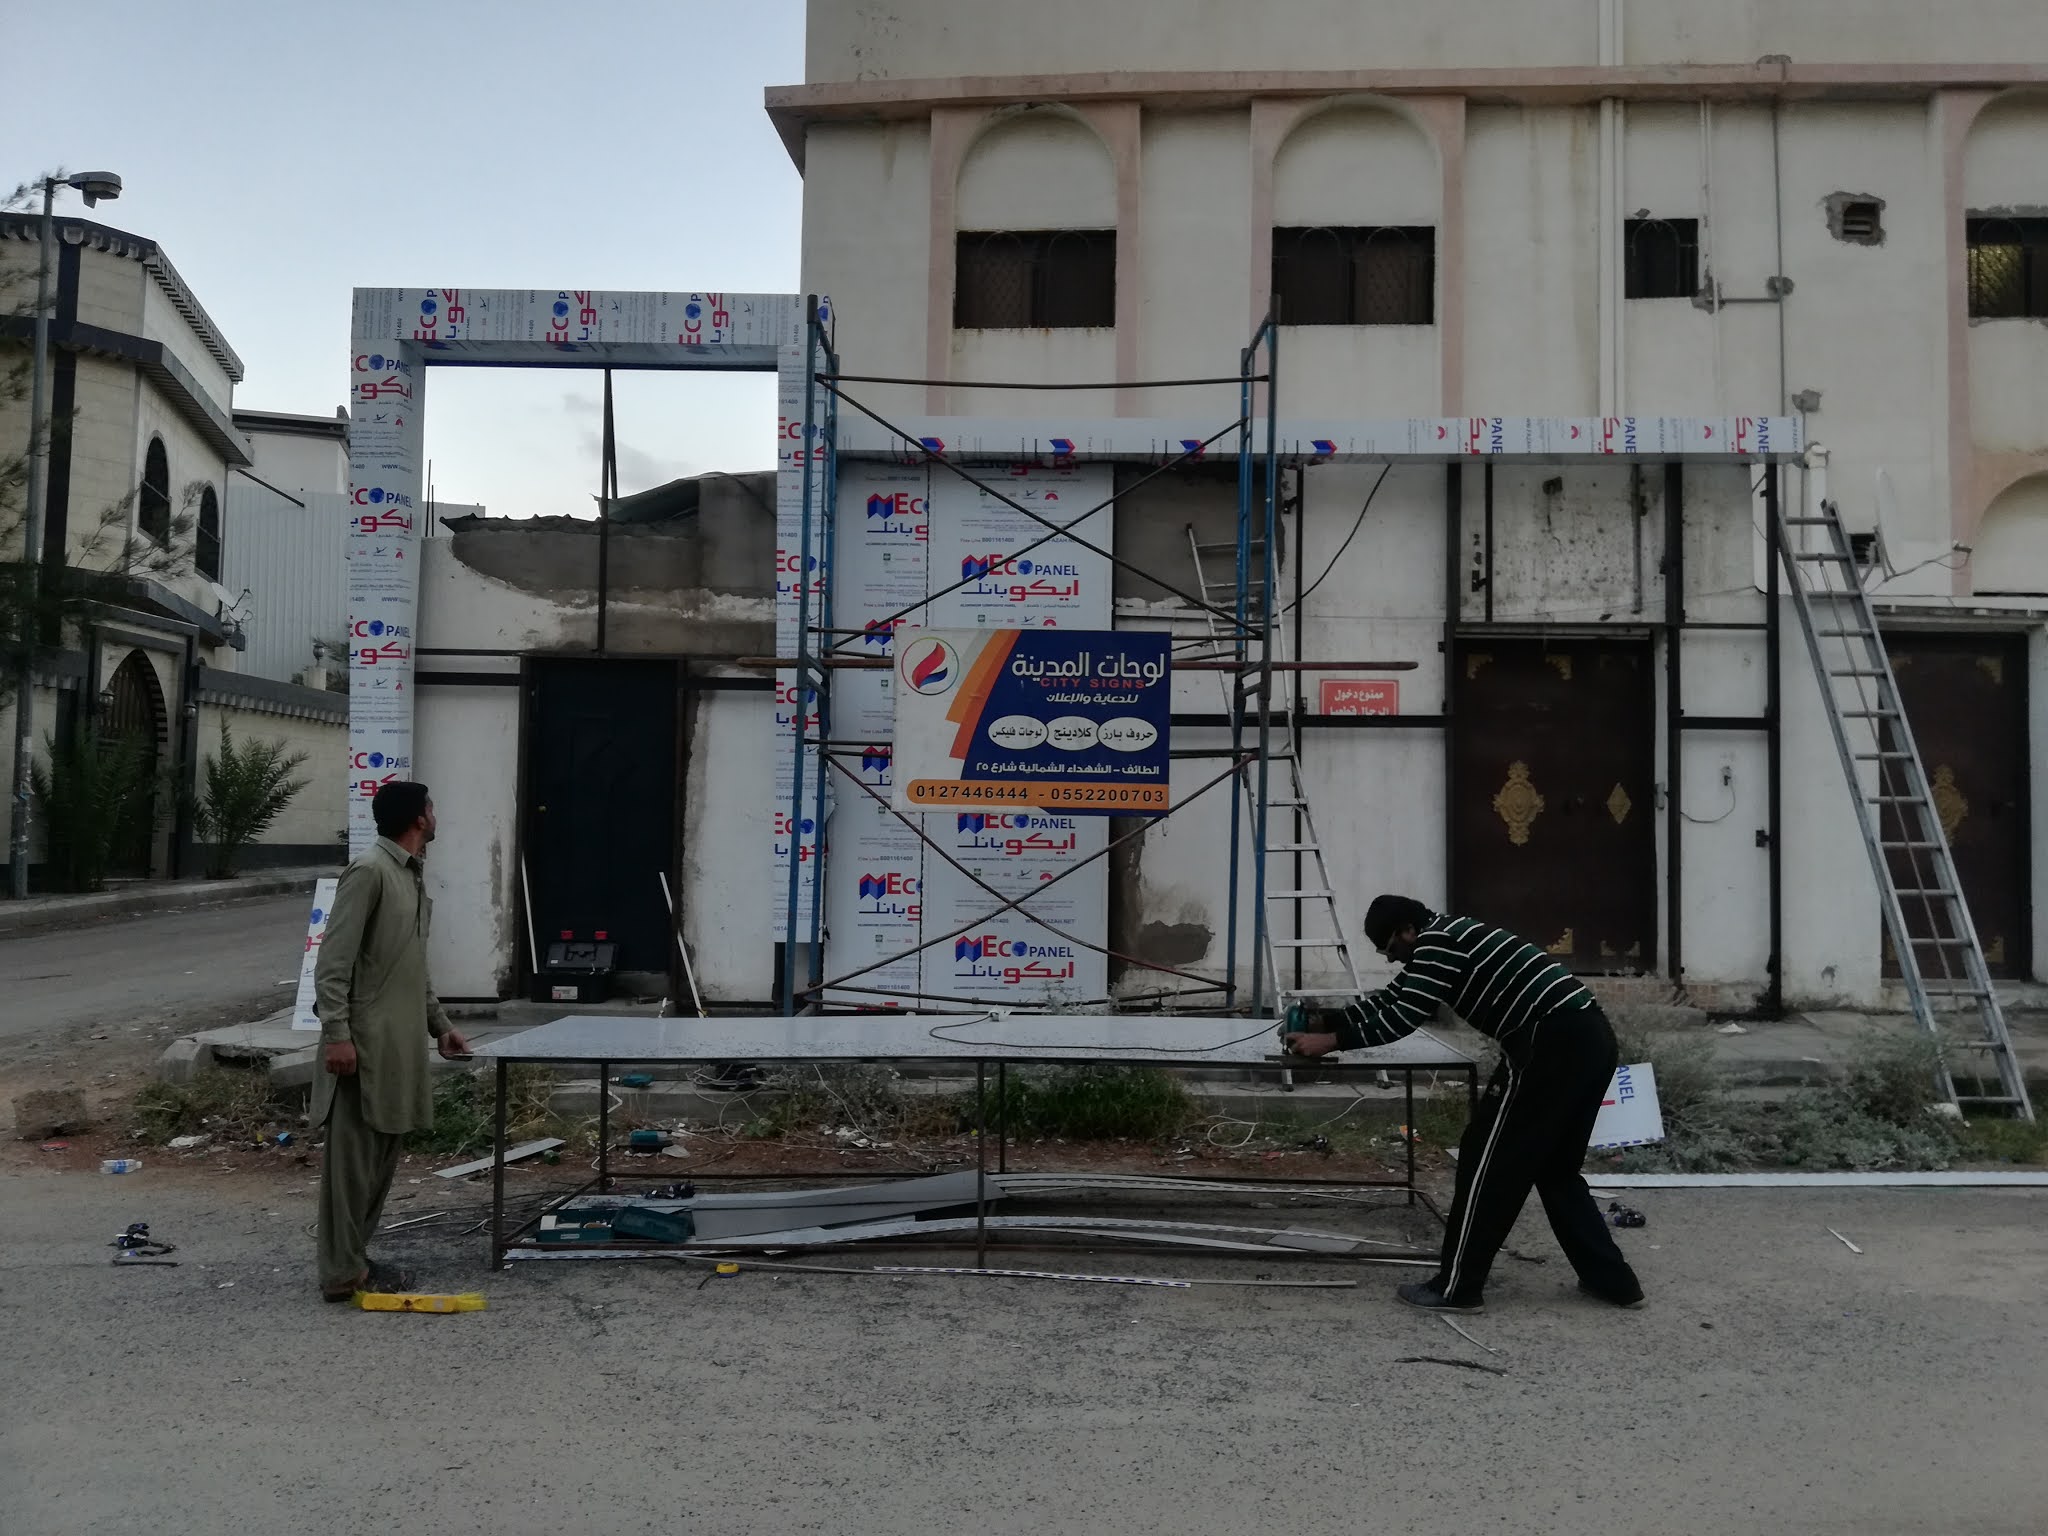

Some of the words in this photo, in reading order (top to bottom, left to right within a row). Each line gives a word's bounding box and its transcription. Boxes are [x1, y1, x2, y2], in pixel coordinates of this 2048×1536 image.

[1491, 417, 1503, 454] PANE
[1624, 416, 1636, 454] PANE
[1757, 416, 1769, 454] PANE
[1035, 564, 1079, 576] PANEL
[1011, 652, 1090, 682] المدينة
[1097, 652, 1165, 687] لوحات
[1040, 678, 1081, 687] CITY
[1090, 678, 1145, 688] SIGNS
[1093, 693, 1139, 705] للدعاية
[1019, 728, 1043, 737] لوحات
[1054, 727, 1092, 740] كلادينج
[1103, 728, 1122, 741] بارز
[1126, 729, 1153, 740] حروف
[990, 761, 1017, 773] شارع
[1019, 761, 1065, 773] الشمالية
[1067, 763, 1112, 773] الشهداء
[1122, 765, 1160, 775] الطائف
[916, 784, 1028, 799] 0127446444
[1051, 787, 1164, 802] 0552200703
[1031, 818, 1076, 829] PANEL
[1029, 946, 1074, 958] PANEL
[1616, 1065, 1635, 1104] ANEL
